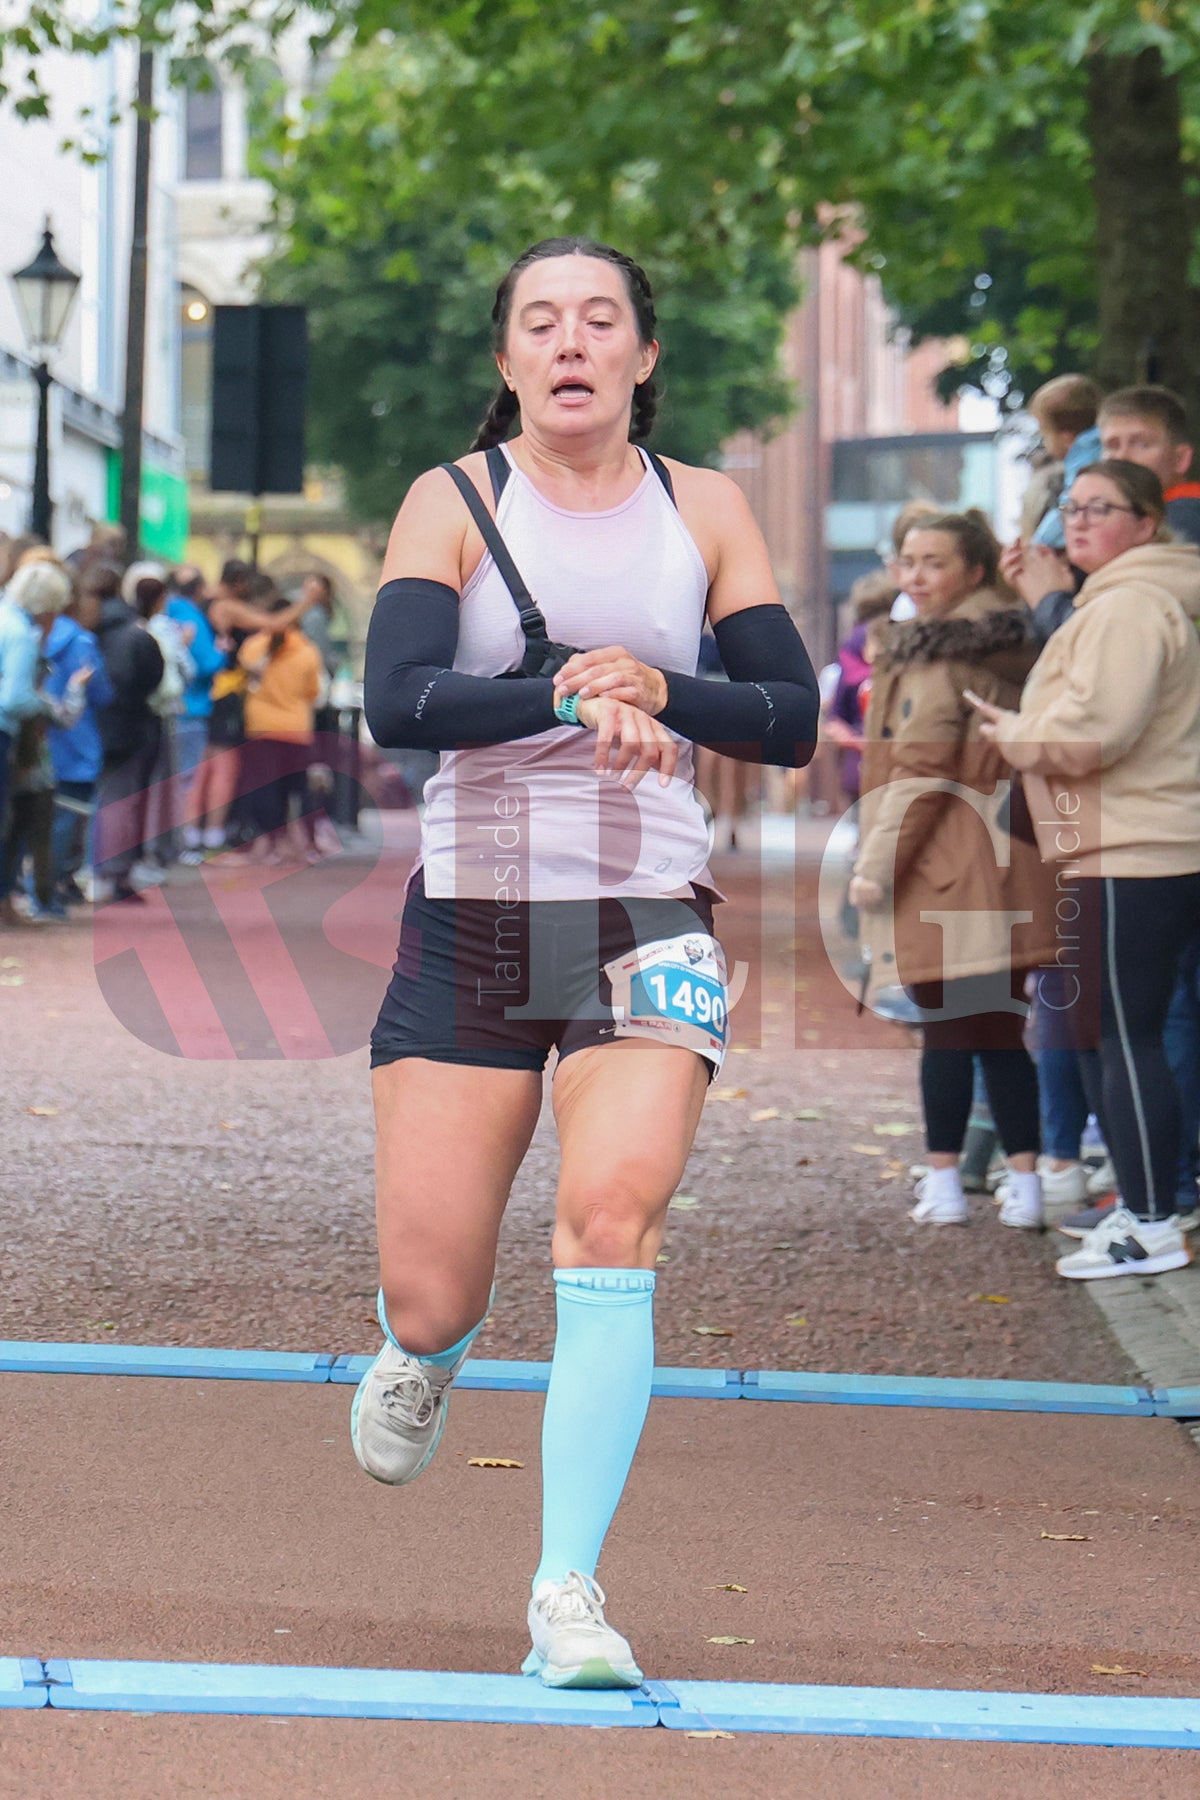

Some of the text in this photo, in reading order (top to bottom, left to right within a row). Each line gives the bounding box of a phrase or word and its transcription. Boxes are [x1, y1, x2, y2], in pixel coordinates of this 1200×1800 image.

[414, 681, 437, 720] AQUA
[650, 973, 724, 1034] 1490
[577, 1277, 653, 1291] HUUB
